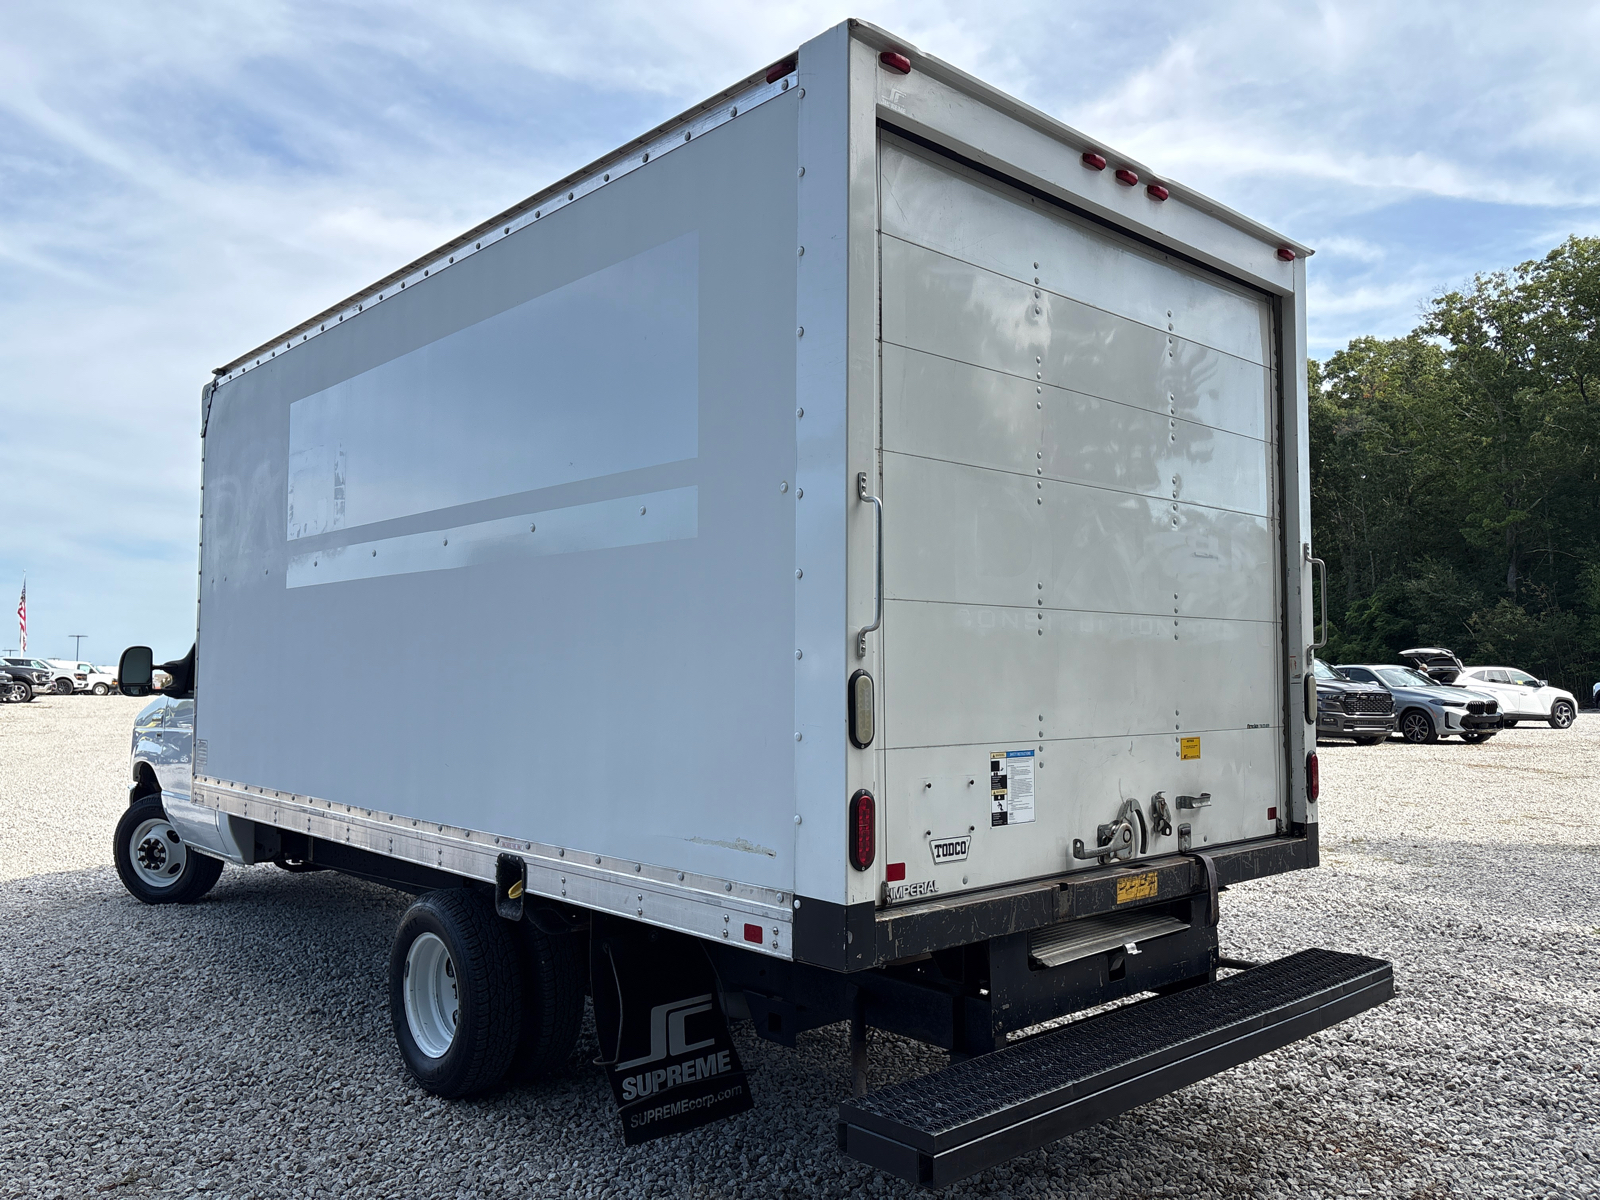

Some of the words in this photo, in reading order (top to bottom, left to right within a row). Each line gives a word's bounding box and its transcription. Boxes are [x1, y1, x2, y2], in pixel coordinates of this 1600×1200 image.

[934, 840, 967, 858] TODCO
[890, 880, 940, 900] IMPERIAL
[621, 1049, 732, 1101] SUPREME
[629, 1084, 743, 1129] SUPREMEcorp.com
